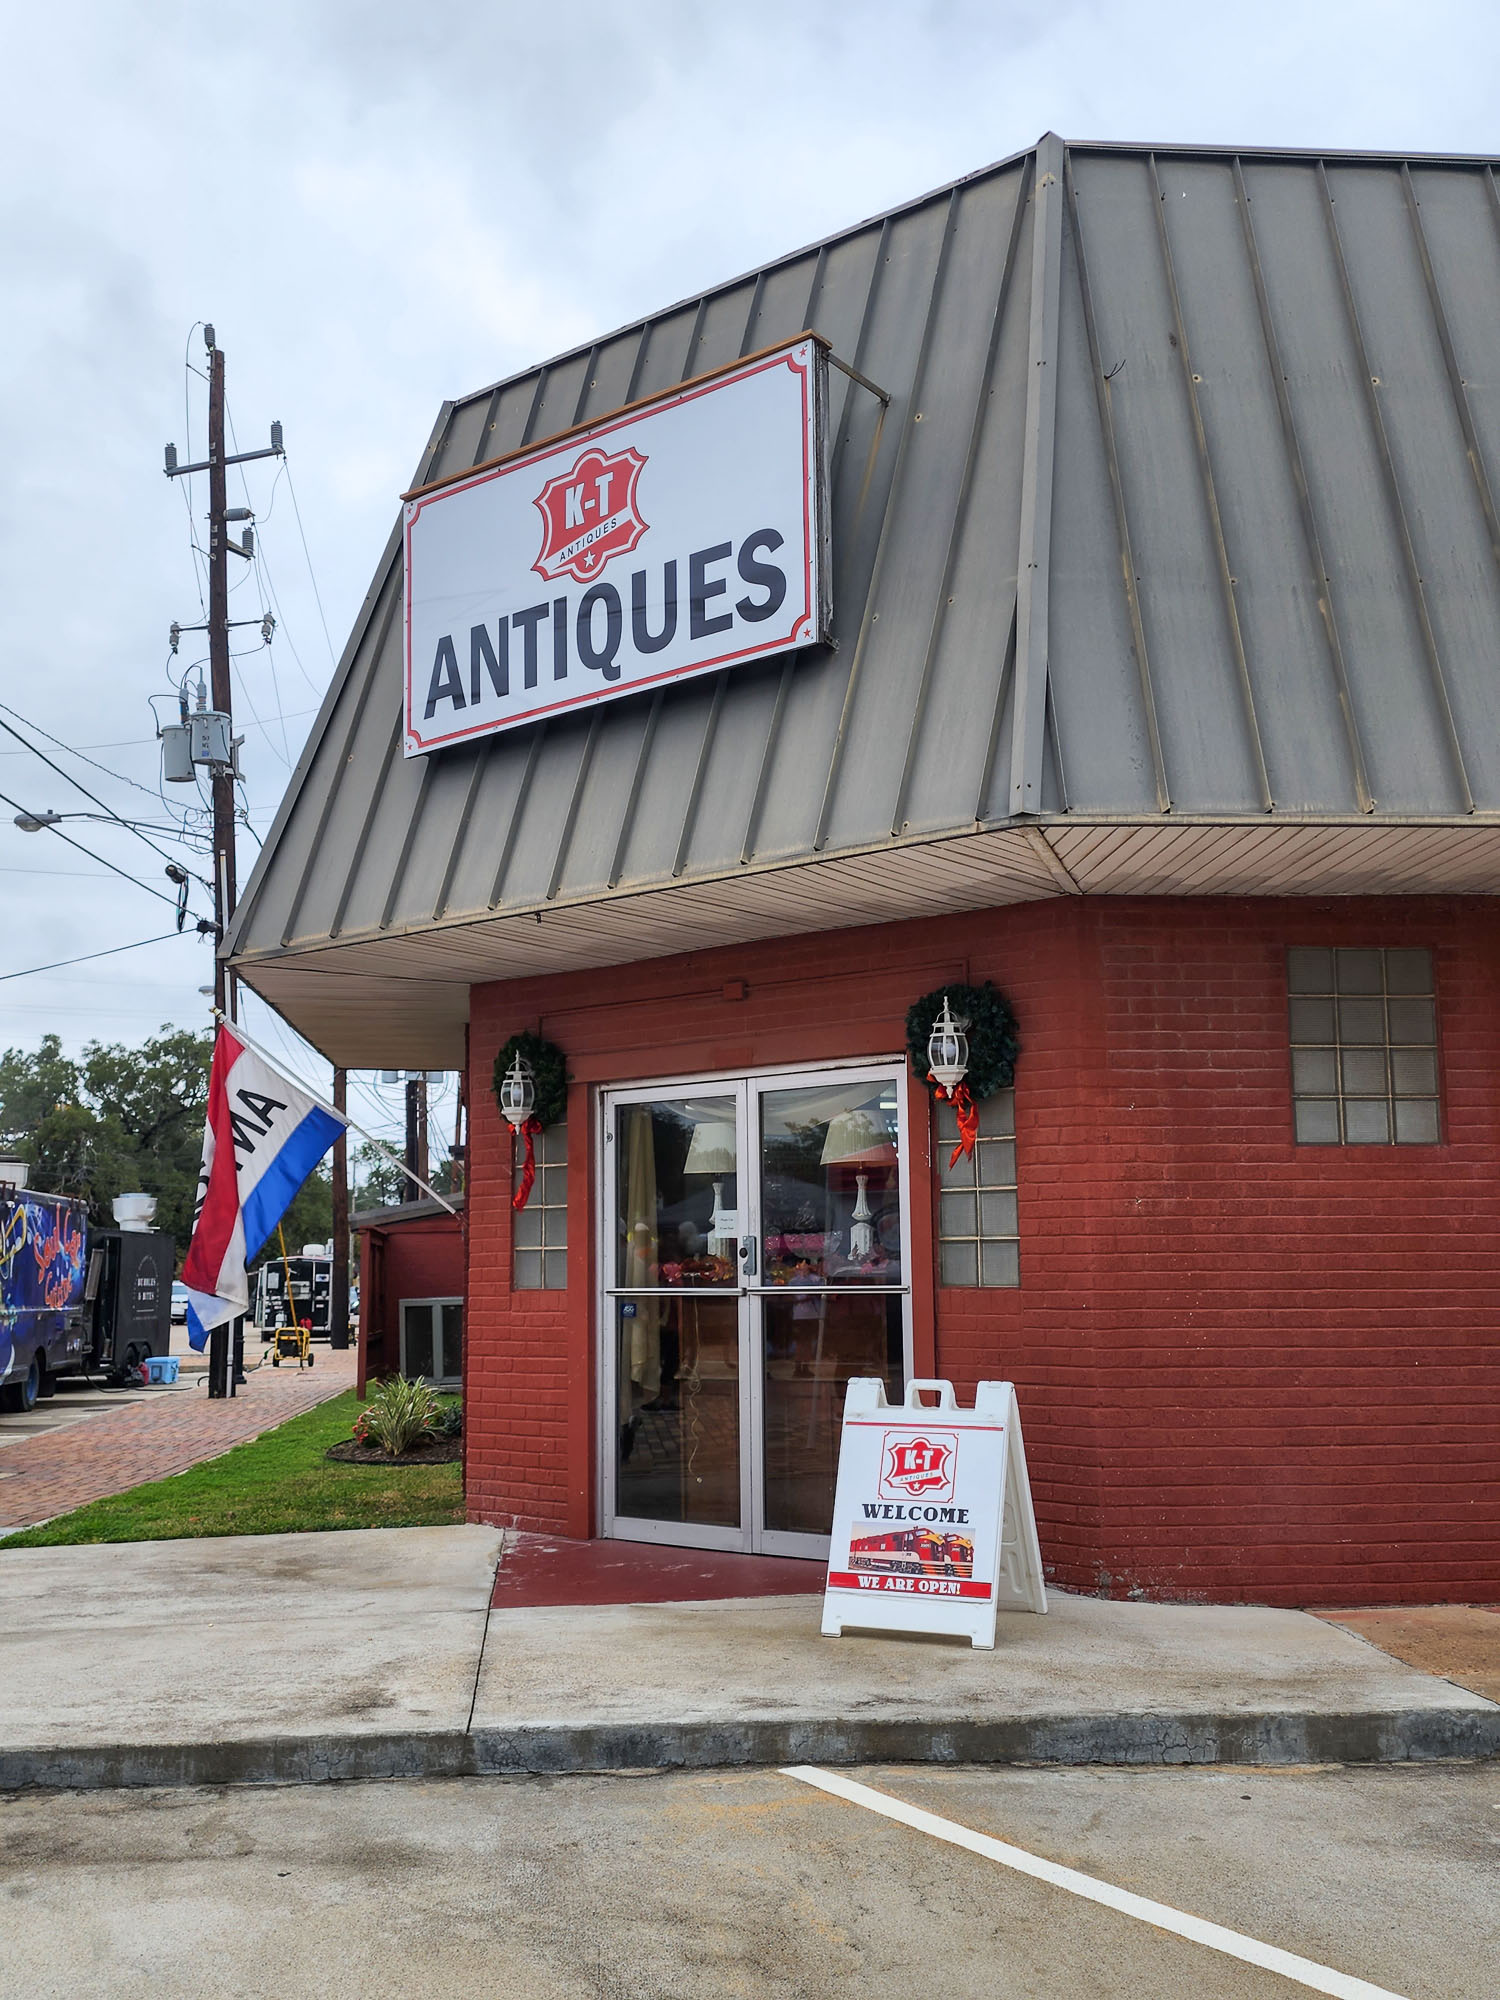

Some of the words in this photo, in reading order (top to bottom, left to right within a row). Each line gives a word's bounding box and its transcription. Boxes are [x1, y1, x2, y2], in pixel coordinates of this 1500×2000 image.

[565, 471, 614, 530] K-T
[559, 518, 617, 562] ANTIQUES
[423, 528, 787, 720] ANTIQUES
[904, 1449, 934, 1470] K-T
[900, 1472, 933, 1482] ANTIQUES
[862, 1503, 970, 1524] WELCOME
[857, 1575, 880, 1588] WE
[884, 1577, 914, 1591] ARE
[918, 1580, 961, 1594] OPEN!
